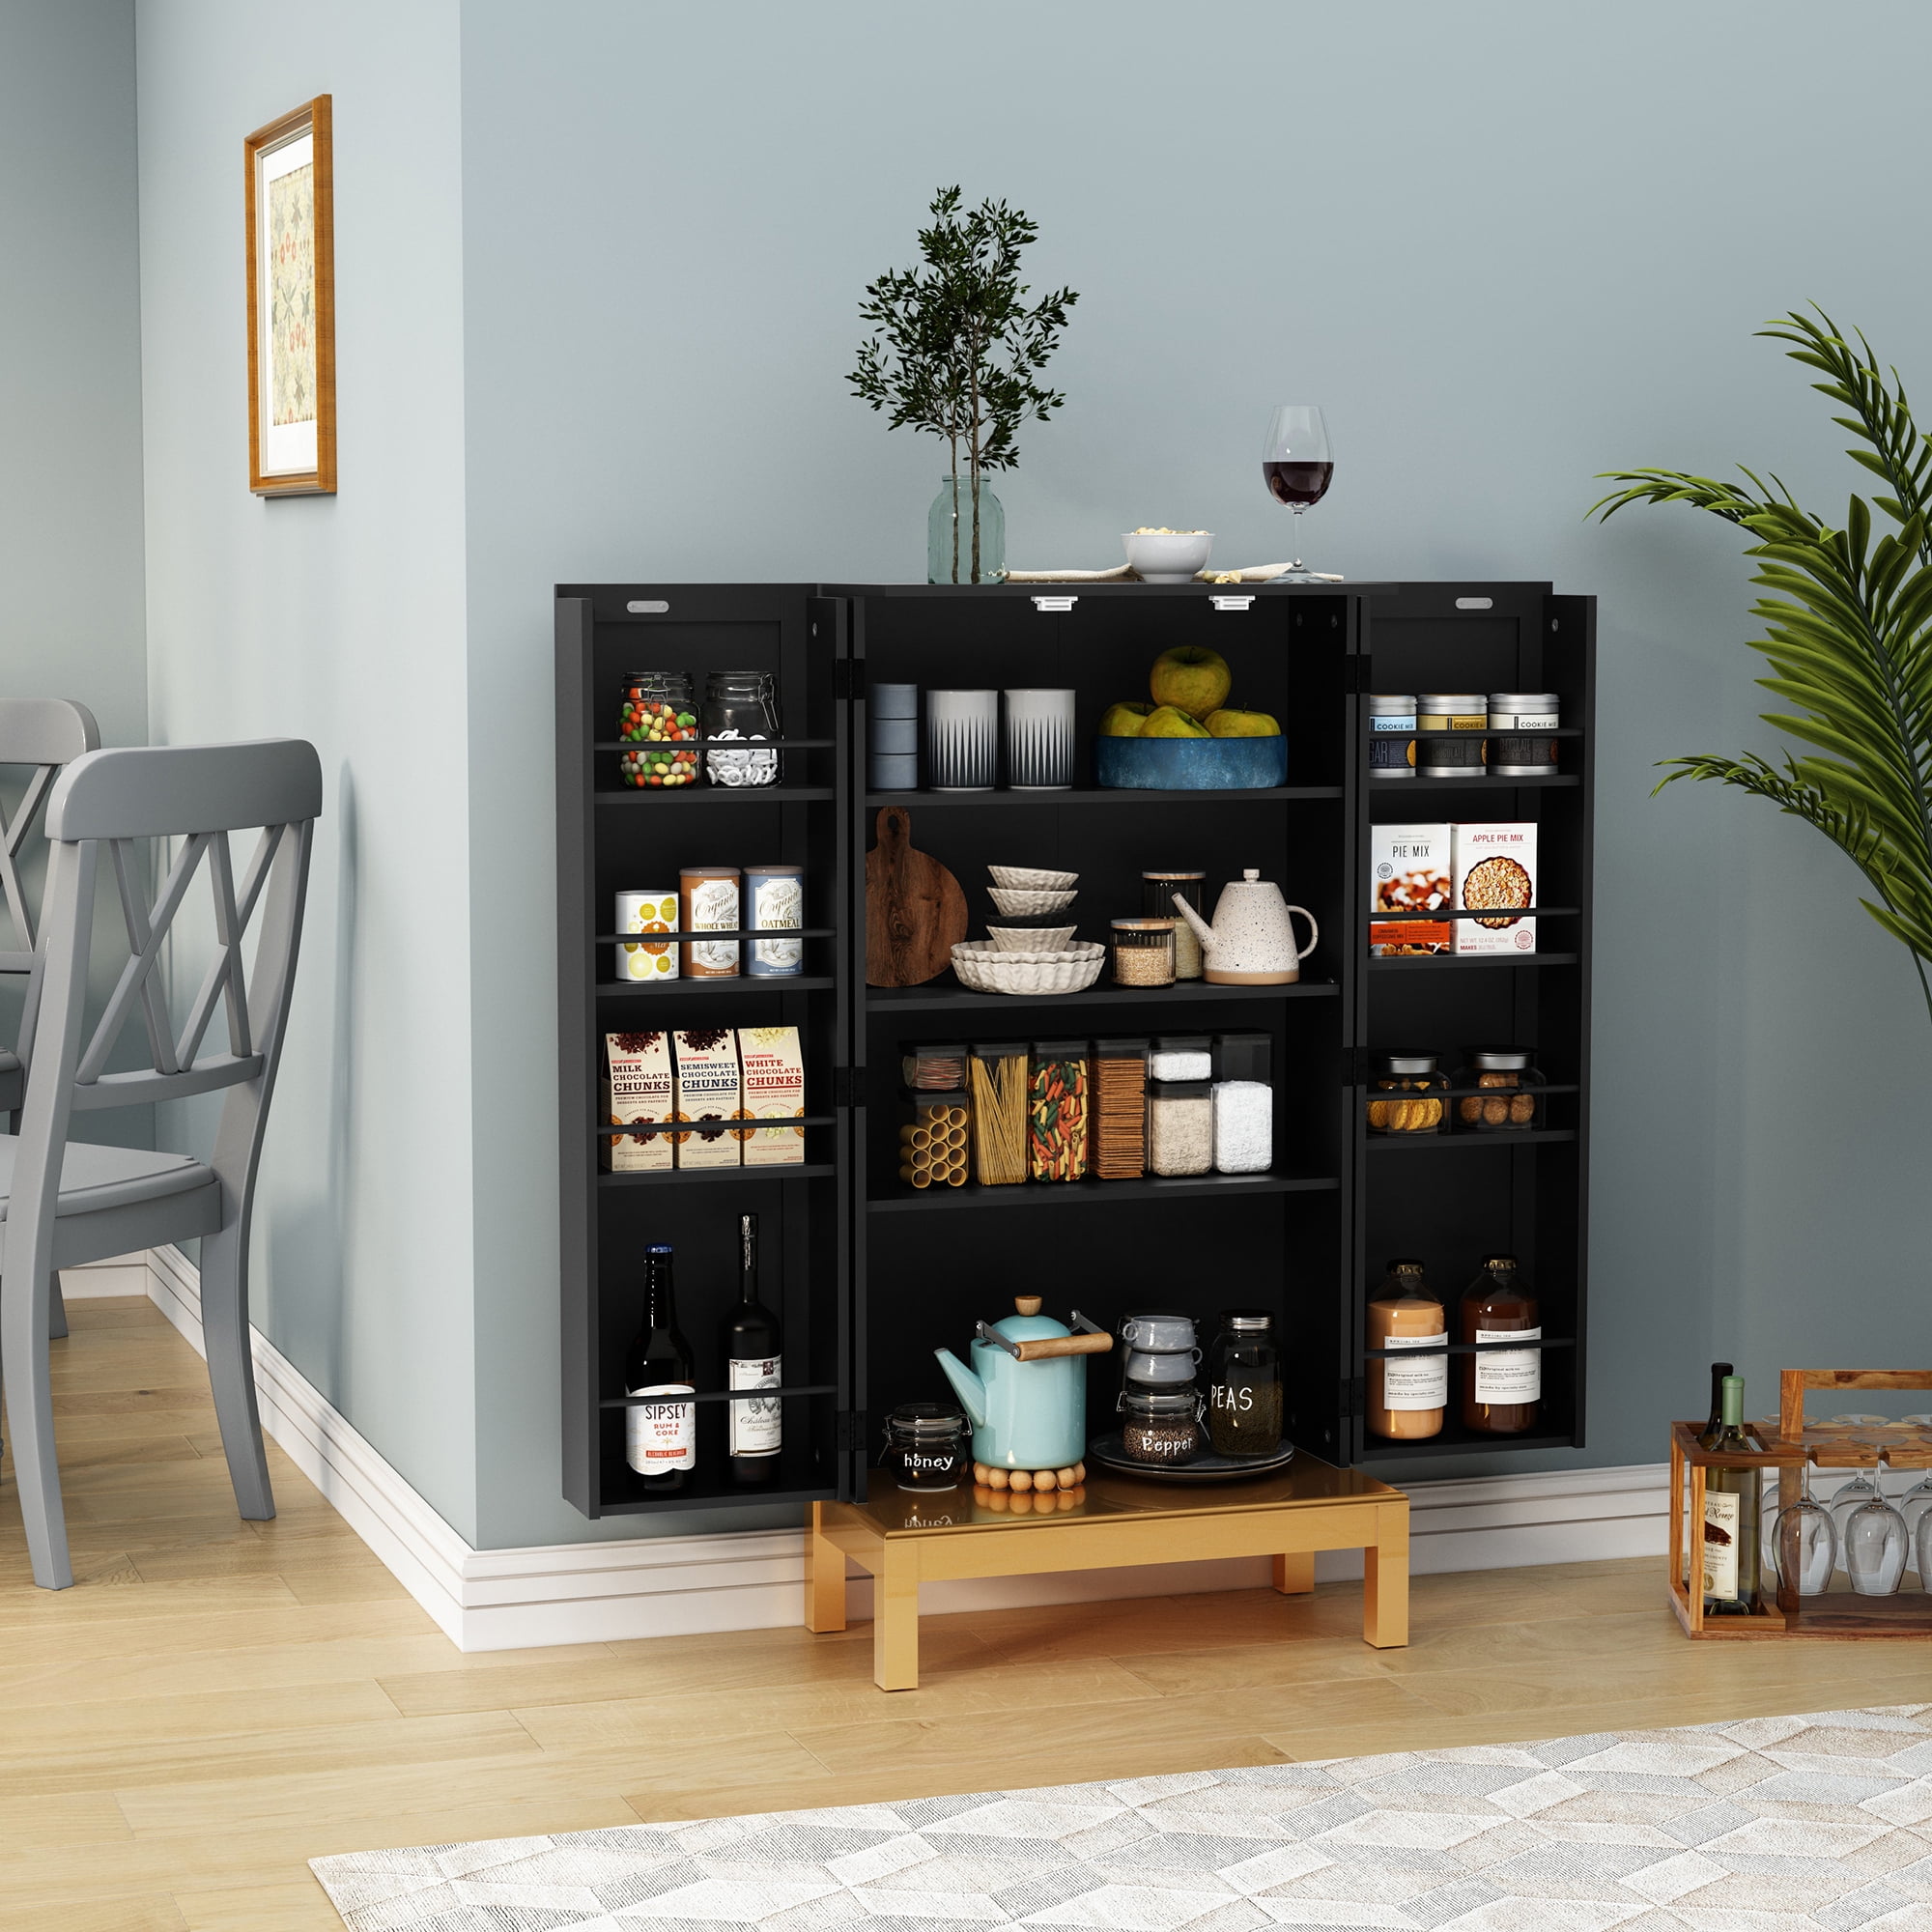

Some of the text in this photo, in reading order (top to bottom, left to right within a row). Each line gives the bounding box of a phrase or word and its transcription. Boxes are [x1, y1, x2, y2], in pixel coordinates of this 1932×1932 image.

[1473, 834, 1495, 842] APPLE
[1392, 845, 1430, 858] PIE MIX
[695, 922, 719, 930] WHOLE
[761, 919, 800, 929] OATMEAL
[681, 1062, 736, 1070] SEMISWEET
[745, 1059, 783, 1067] WHITE
[612, 1065, 642, 1073] MILK
[613, 1073, 670, 1081] CHOCOLATE
[747, 1076, 802, 1086] CHUNKS
[614, 1080, 670, 1092] CHUNKS
[682, 1078, 738, 1089] CHUNKS
[1211, 1384, 1253, 1411] PEAS
[645, 1404, 686, 1420] SIPSEY
[1142, 1437, 1193, 1456] Pepper
[904, 1453, 954, 1471] honey
